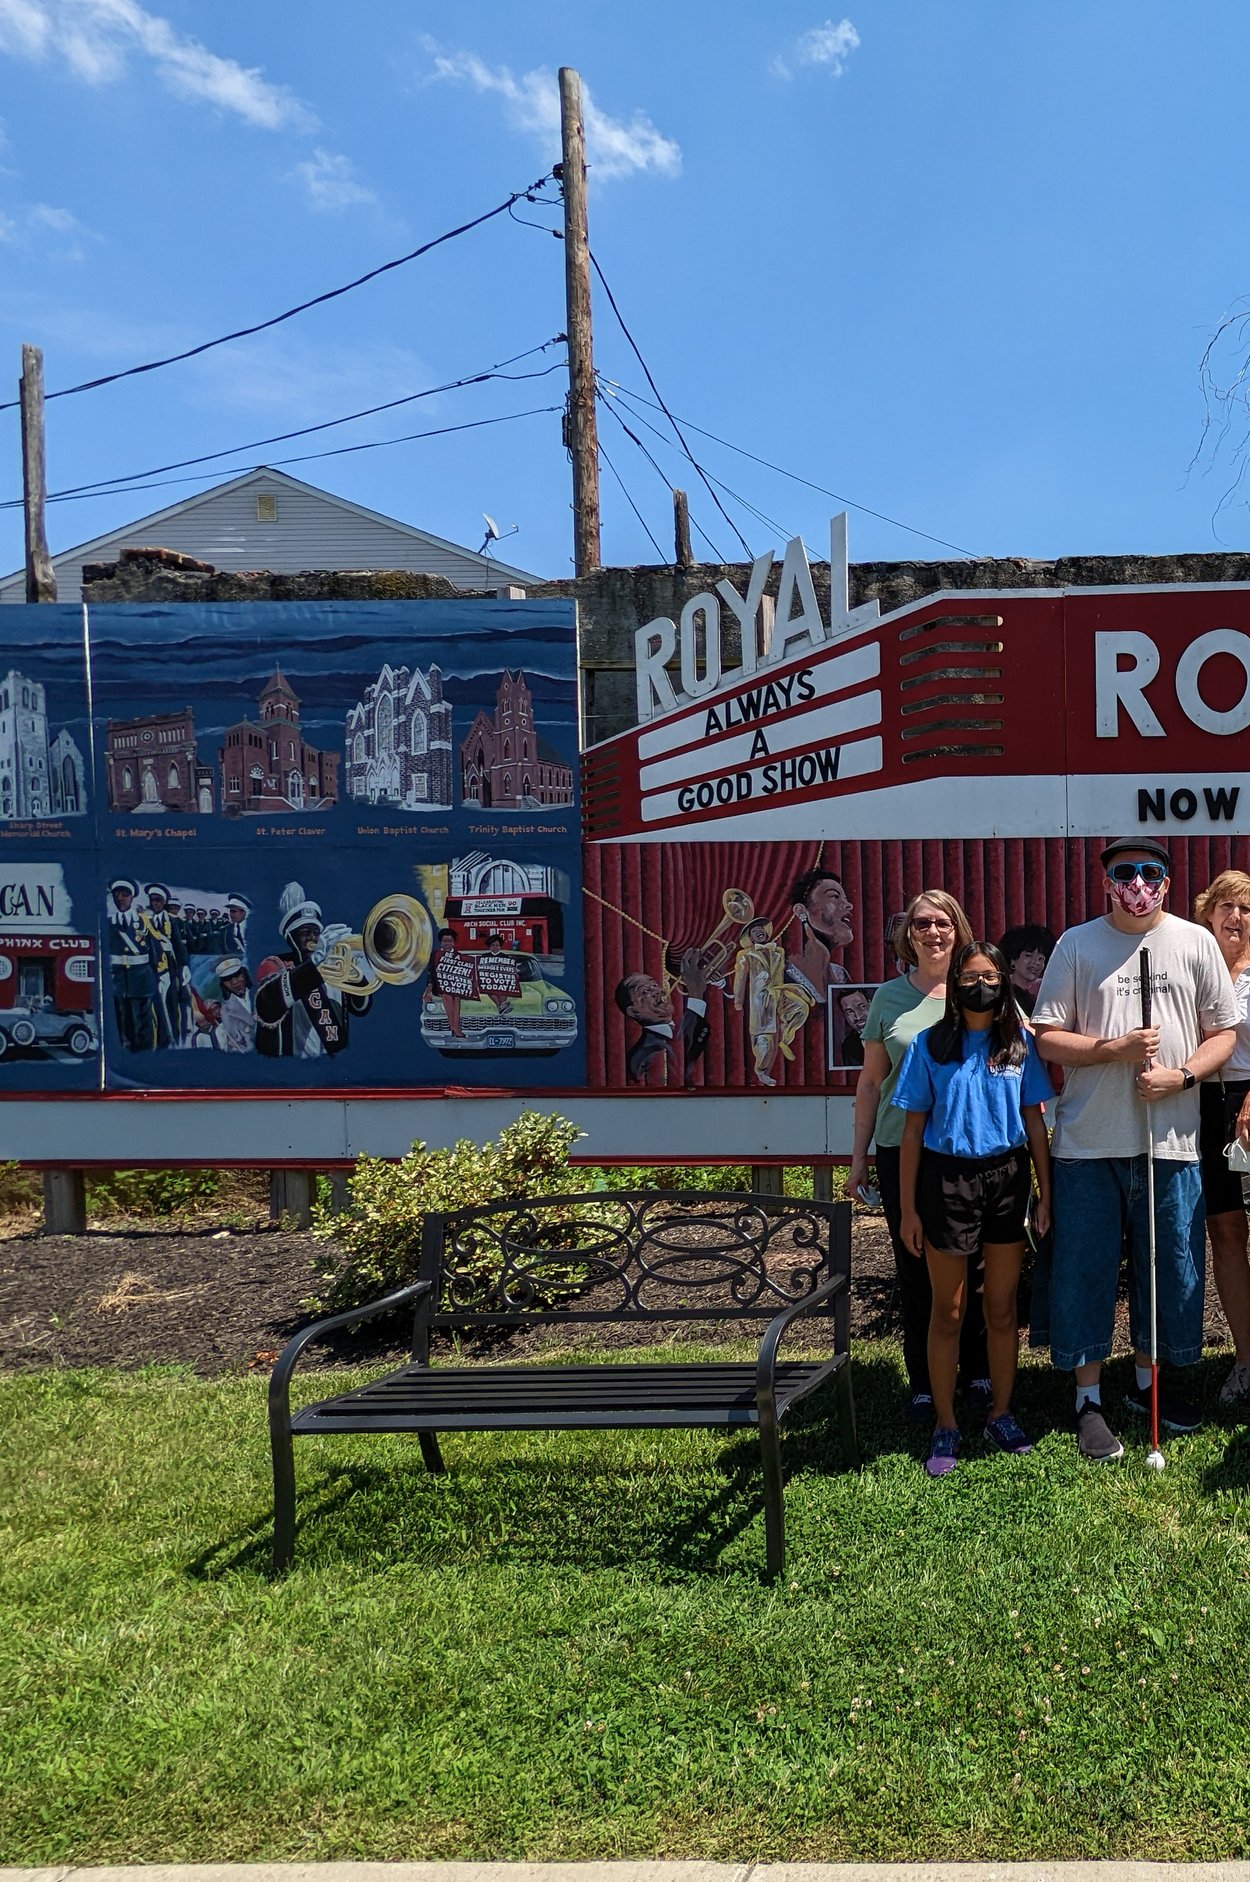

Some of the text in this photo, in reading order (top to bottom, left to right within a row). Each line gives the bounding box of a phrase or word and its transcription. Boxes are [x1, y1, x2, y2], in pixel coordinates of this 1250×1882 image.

[635, 511, 880, 724] ROYAL
[705, 670, 815, 736] ALWAYS
[749, 729, 770, 760] A
[677, 746, 841, 812] GOOD SHOW
[1137, 786, 1241, 821] NOW
[115, 828, 197, 840] St. Mary's Chapel
[256, 827, 326, 835] St. Peter Claver
[357, 826, 449, 837] Union Baptist Church
[468, 825, 567, 837] Trinity Baptist Church
[0, 883, 55, 918] CAN
[49, 939, 90, 949] CLUB
[440, 956, 457, 965] FIRST
[479, 957, 515, 966] REMEMBER
[437, 963, 472, 977] CITIZEN!
[479, 971, 515, 979] REGISTER
[437, 972, 472, 985] REGISTER
[1117, 974, 1130, 984] be
[450, 981, 472, 990] VOTE
[1116, 986, 1130, 996] it's
